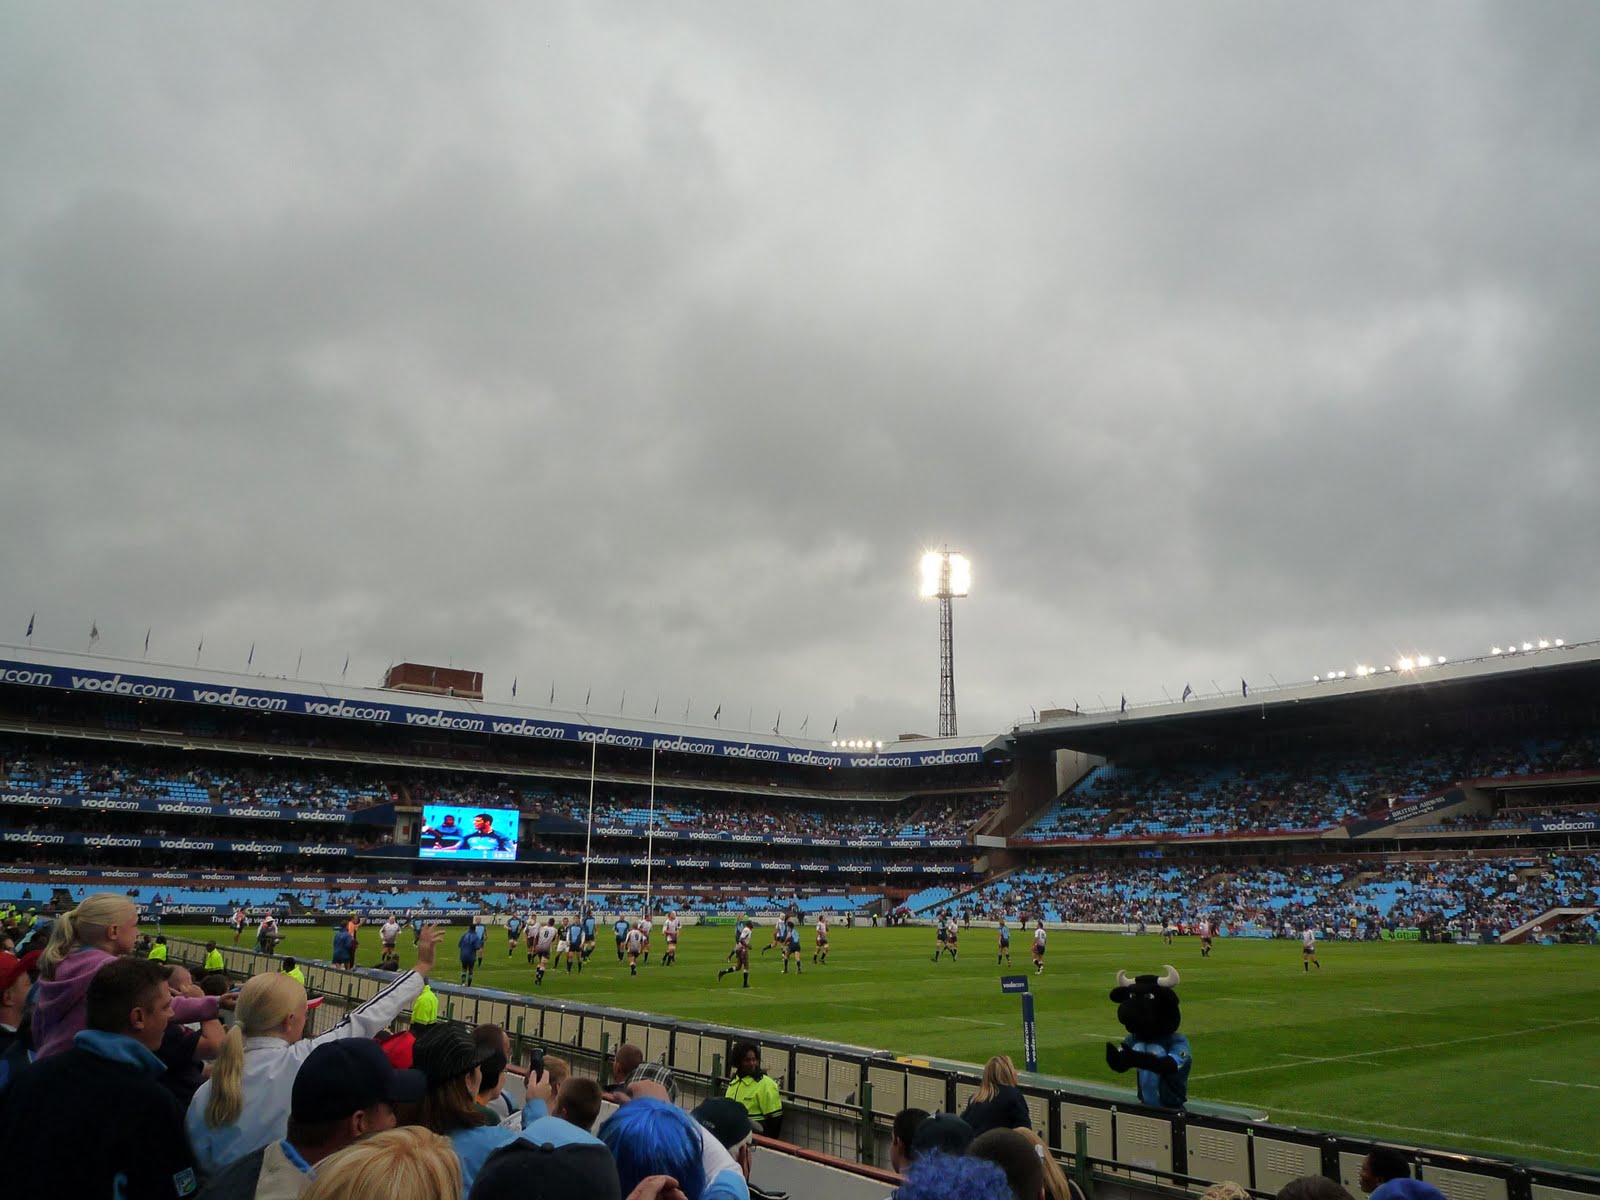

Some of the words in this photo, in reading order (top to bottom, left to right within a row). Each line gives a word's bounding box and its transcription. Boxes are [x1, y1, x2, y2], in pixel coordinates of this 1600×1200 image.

[71, 675, 175, 698] vodacom
[193, 688, 287, 710] vodacom
[304, 700, 391, 721] vodacom
[405, 710, 484, 731] vodacom
[492, 720, 565, 739] vodacom
[577, 729, 643, 747] vodacom
[653, 737, 715, 754] vodacom
[723, 744, 780, 760] vodacom
[919, 748, 978, 765] vodacom
[787, 751, 842, 767] vodacom
[850, 751, 911, 767] vodacom
[1, 792, 62, 806] vodacom
[81, 798, 139, 810] vodacom
[157, 802, 212, 814] vodacom
[229, 806, 281, 818] vodacom
[296, 810, 346, 821] vodacom
[1541, 820, 1595, 831] vodacom
[596, 826, 633, 836] vodacom
[644, 828, 679, 838] vodacom
[3, 830, 65, 844] vodacom
[83, 834, 142, 848] vodacom
[731, 832, 764, 842] vodacom
[772, 835, 802, 844] vodacom
[811, 836, 841, 846] vodacom
[847, 837, 883, 847] vodacom
[929, 837, 962, 847] vodacom
[160, 838, 214, 850] vodacom
[231, 841, 283, 853] vodacom
[890, 838, 921, 847] vodacom
[298, 843, 347, 855] vodacom
[582, 856, 619, 864] vodacom
[630, 856, 666, 866] vodacom
[676, 858, 710, 867] vodacom
[719, 859, 752, 869] vodacom
[0, 866, 35, 875] odacom
[761, 861, 791, 870] vodacom
[800, 862, 830, 871] vodacom
[837, 863, 872, 873] vodacom
[882, 864, 913, 873] vodacom
[922, 863, 955, 874] vodacom
[48, 868, 88, 877] vodacom
[101, 869, 139, 878] vodacom
[152, 871, 189, 879] vodacom
[201, 873, 235, 881] vodacom
[248, 874, 281, 882] vodacom
[378, 877, 408, 885] vodacom
[418, 878, 447, 886] vodacom
[457, 879, 486, 887] vodacom
[543, 930, 550, 939] 8
[634, 933, 640, 941] 9
[1003, 981, 1025, 989] vodacom
